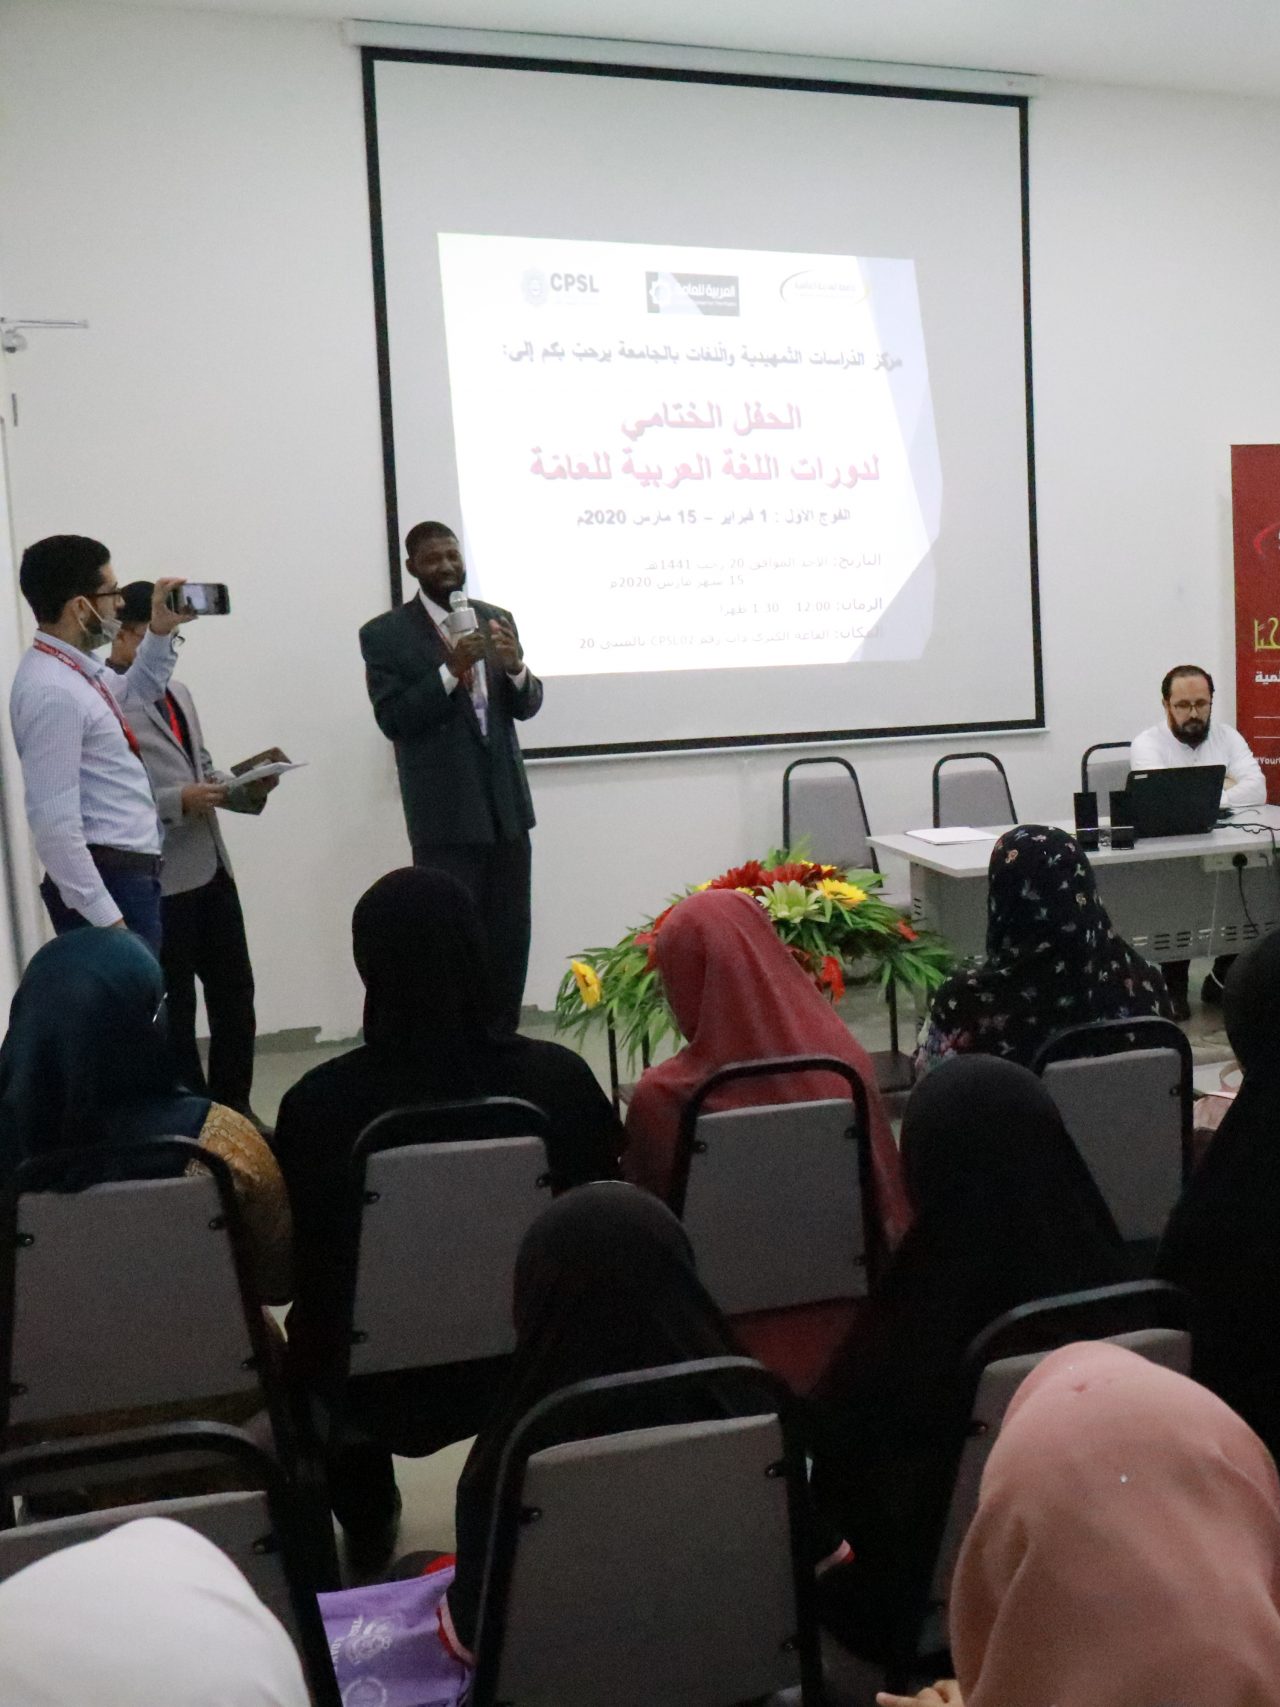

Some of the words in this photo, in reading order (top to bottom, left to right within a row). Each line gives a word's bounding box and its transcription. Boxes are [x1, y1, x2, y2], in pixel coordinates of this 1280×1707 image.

[549, 272, 600, 293] CPSL
[541, 340, 566, 365] بكم
[617, 340, 680, 365] بالجامعة
[872, 350, 904, 373] مركز
[620, 399, 723, 442] الختامي
[733, 400, 802, 437] الحفل
[620, 445, 712, 490] العربية
[722, 446, 780, 481] اللغة
[789, 453, 881, 490] لدورات
[576, 508, 627, 526] 2020م
[633, 508, 672, 526] مارس
[677, 510, 697, 524] 15
[759, 509, 768, 523] 1
[818, 508, 851, 526] الفوج
[579, 637, 596, 650] 20
